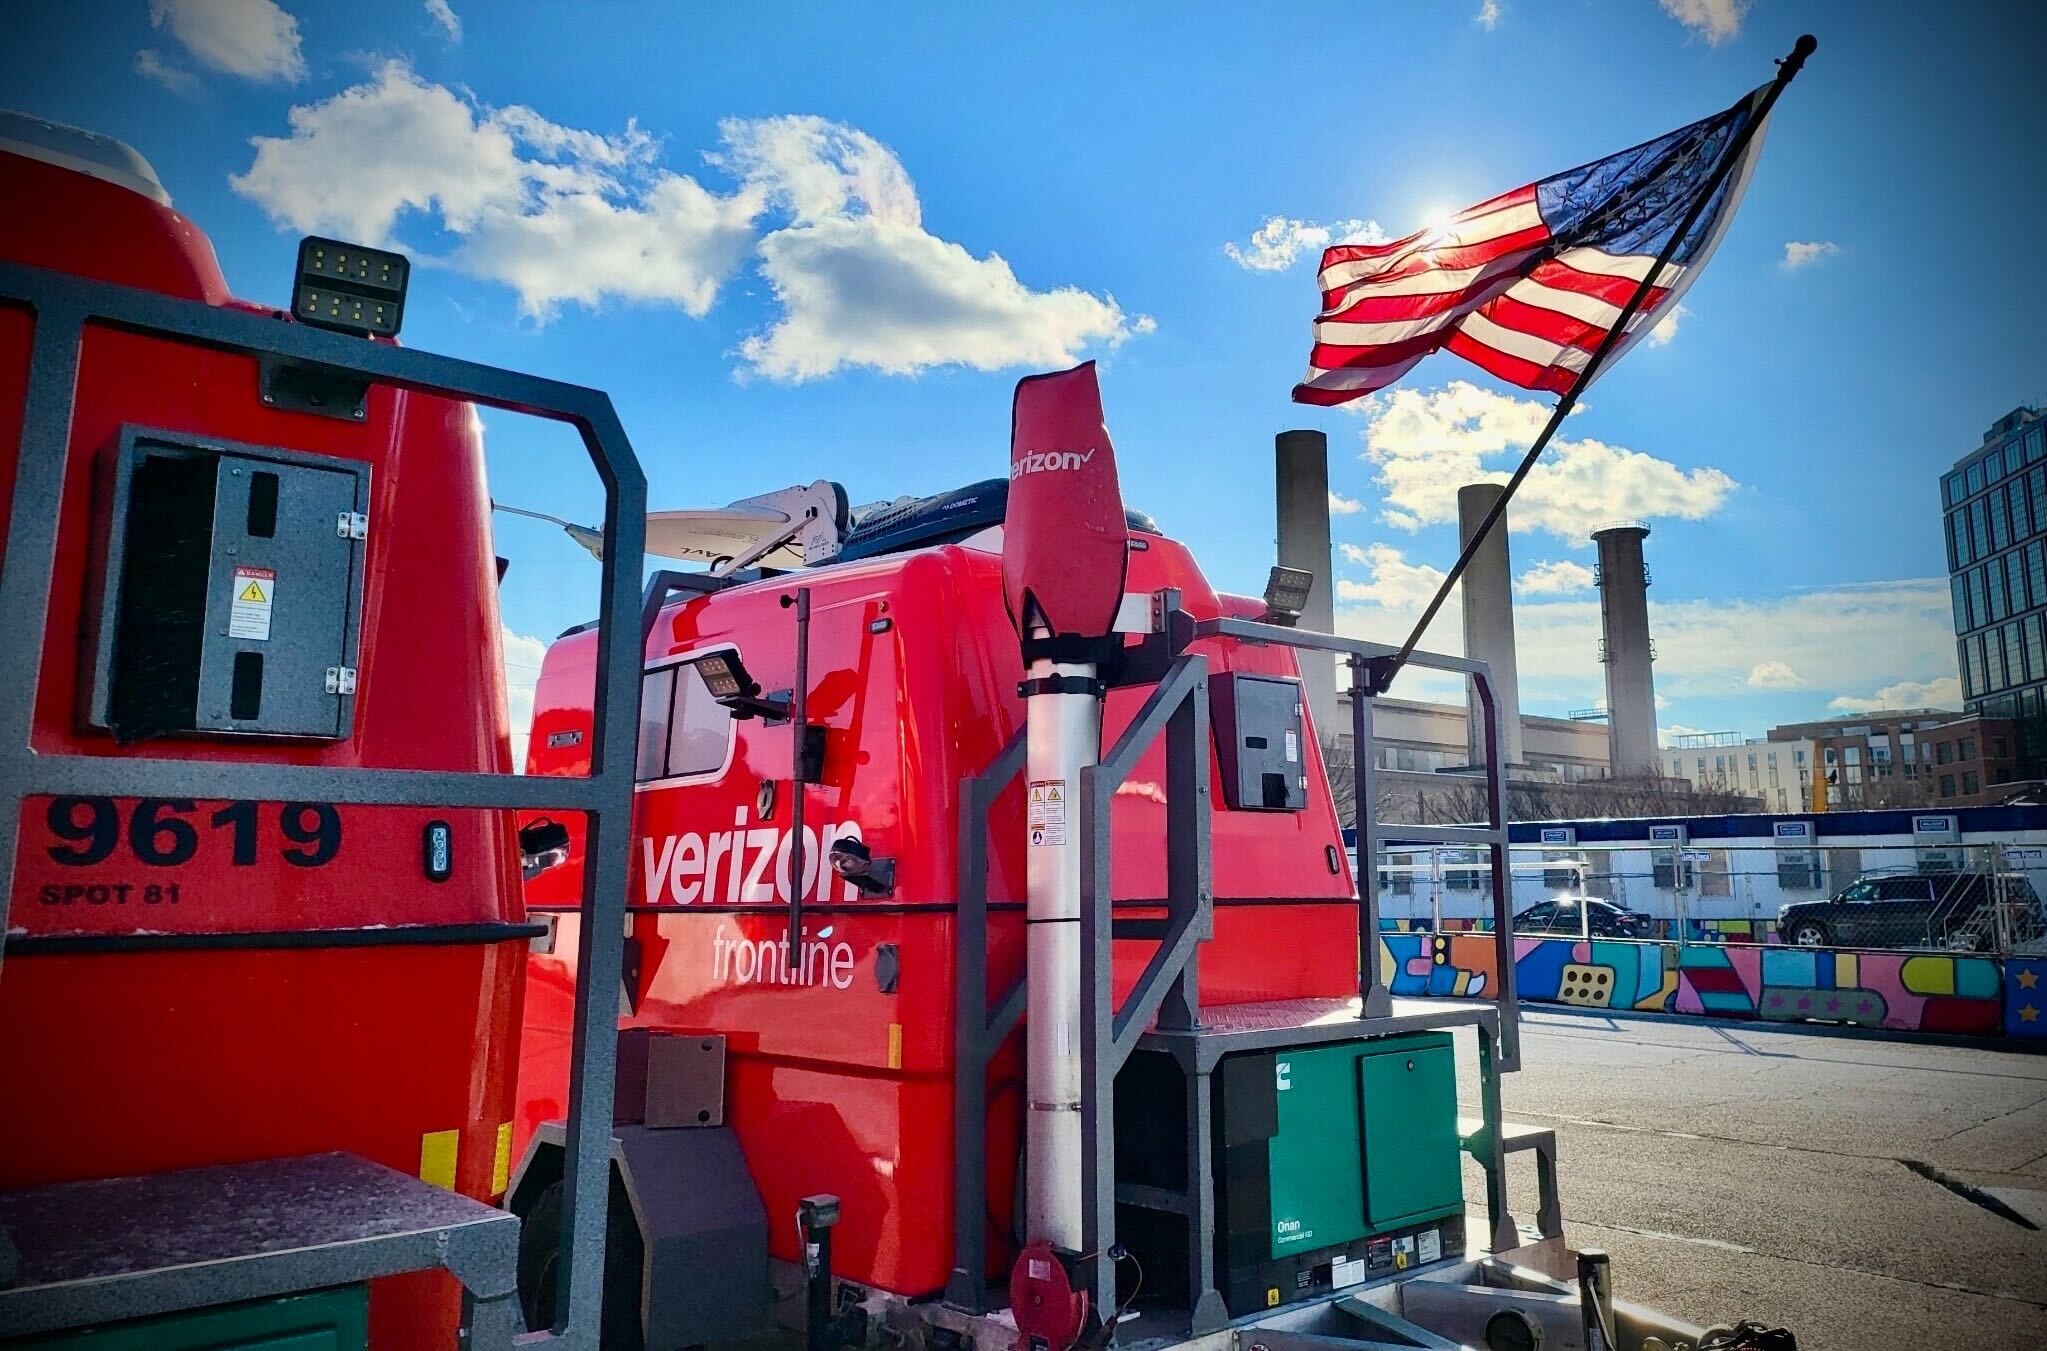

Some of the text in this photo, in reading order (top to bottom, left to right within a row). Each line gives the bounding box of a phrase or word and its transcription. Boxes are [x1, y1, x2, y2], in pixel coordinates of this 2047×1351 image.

[1011, 450, 1081, 480] erizon
[47, 795, 342, 867] 9619
[643, 805, 862, 904] verizon
[39, 884, 180, 906] SPOT 81
[1277, 1220, 1300, 1233] Onan
